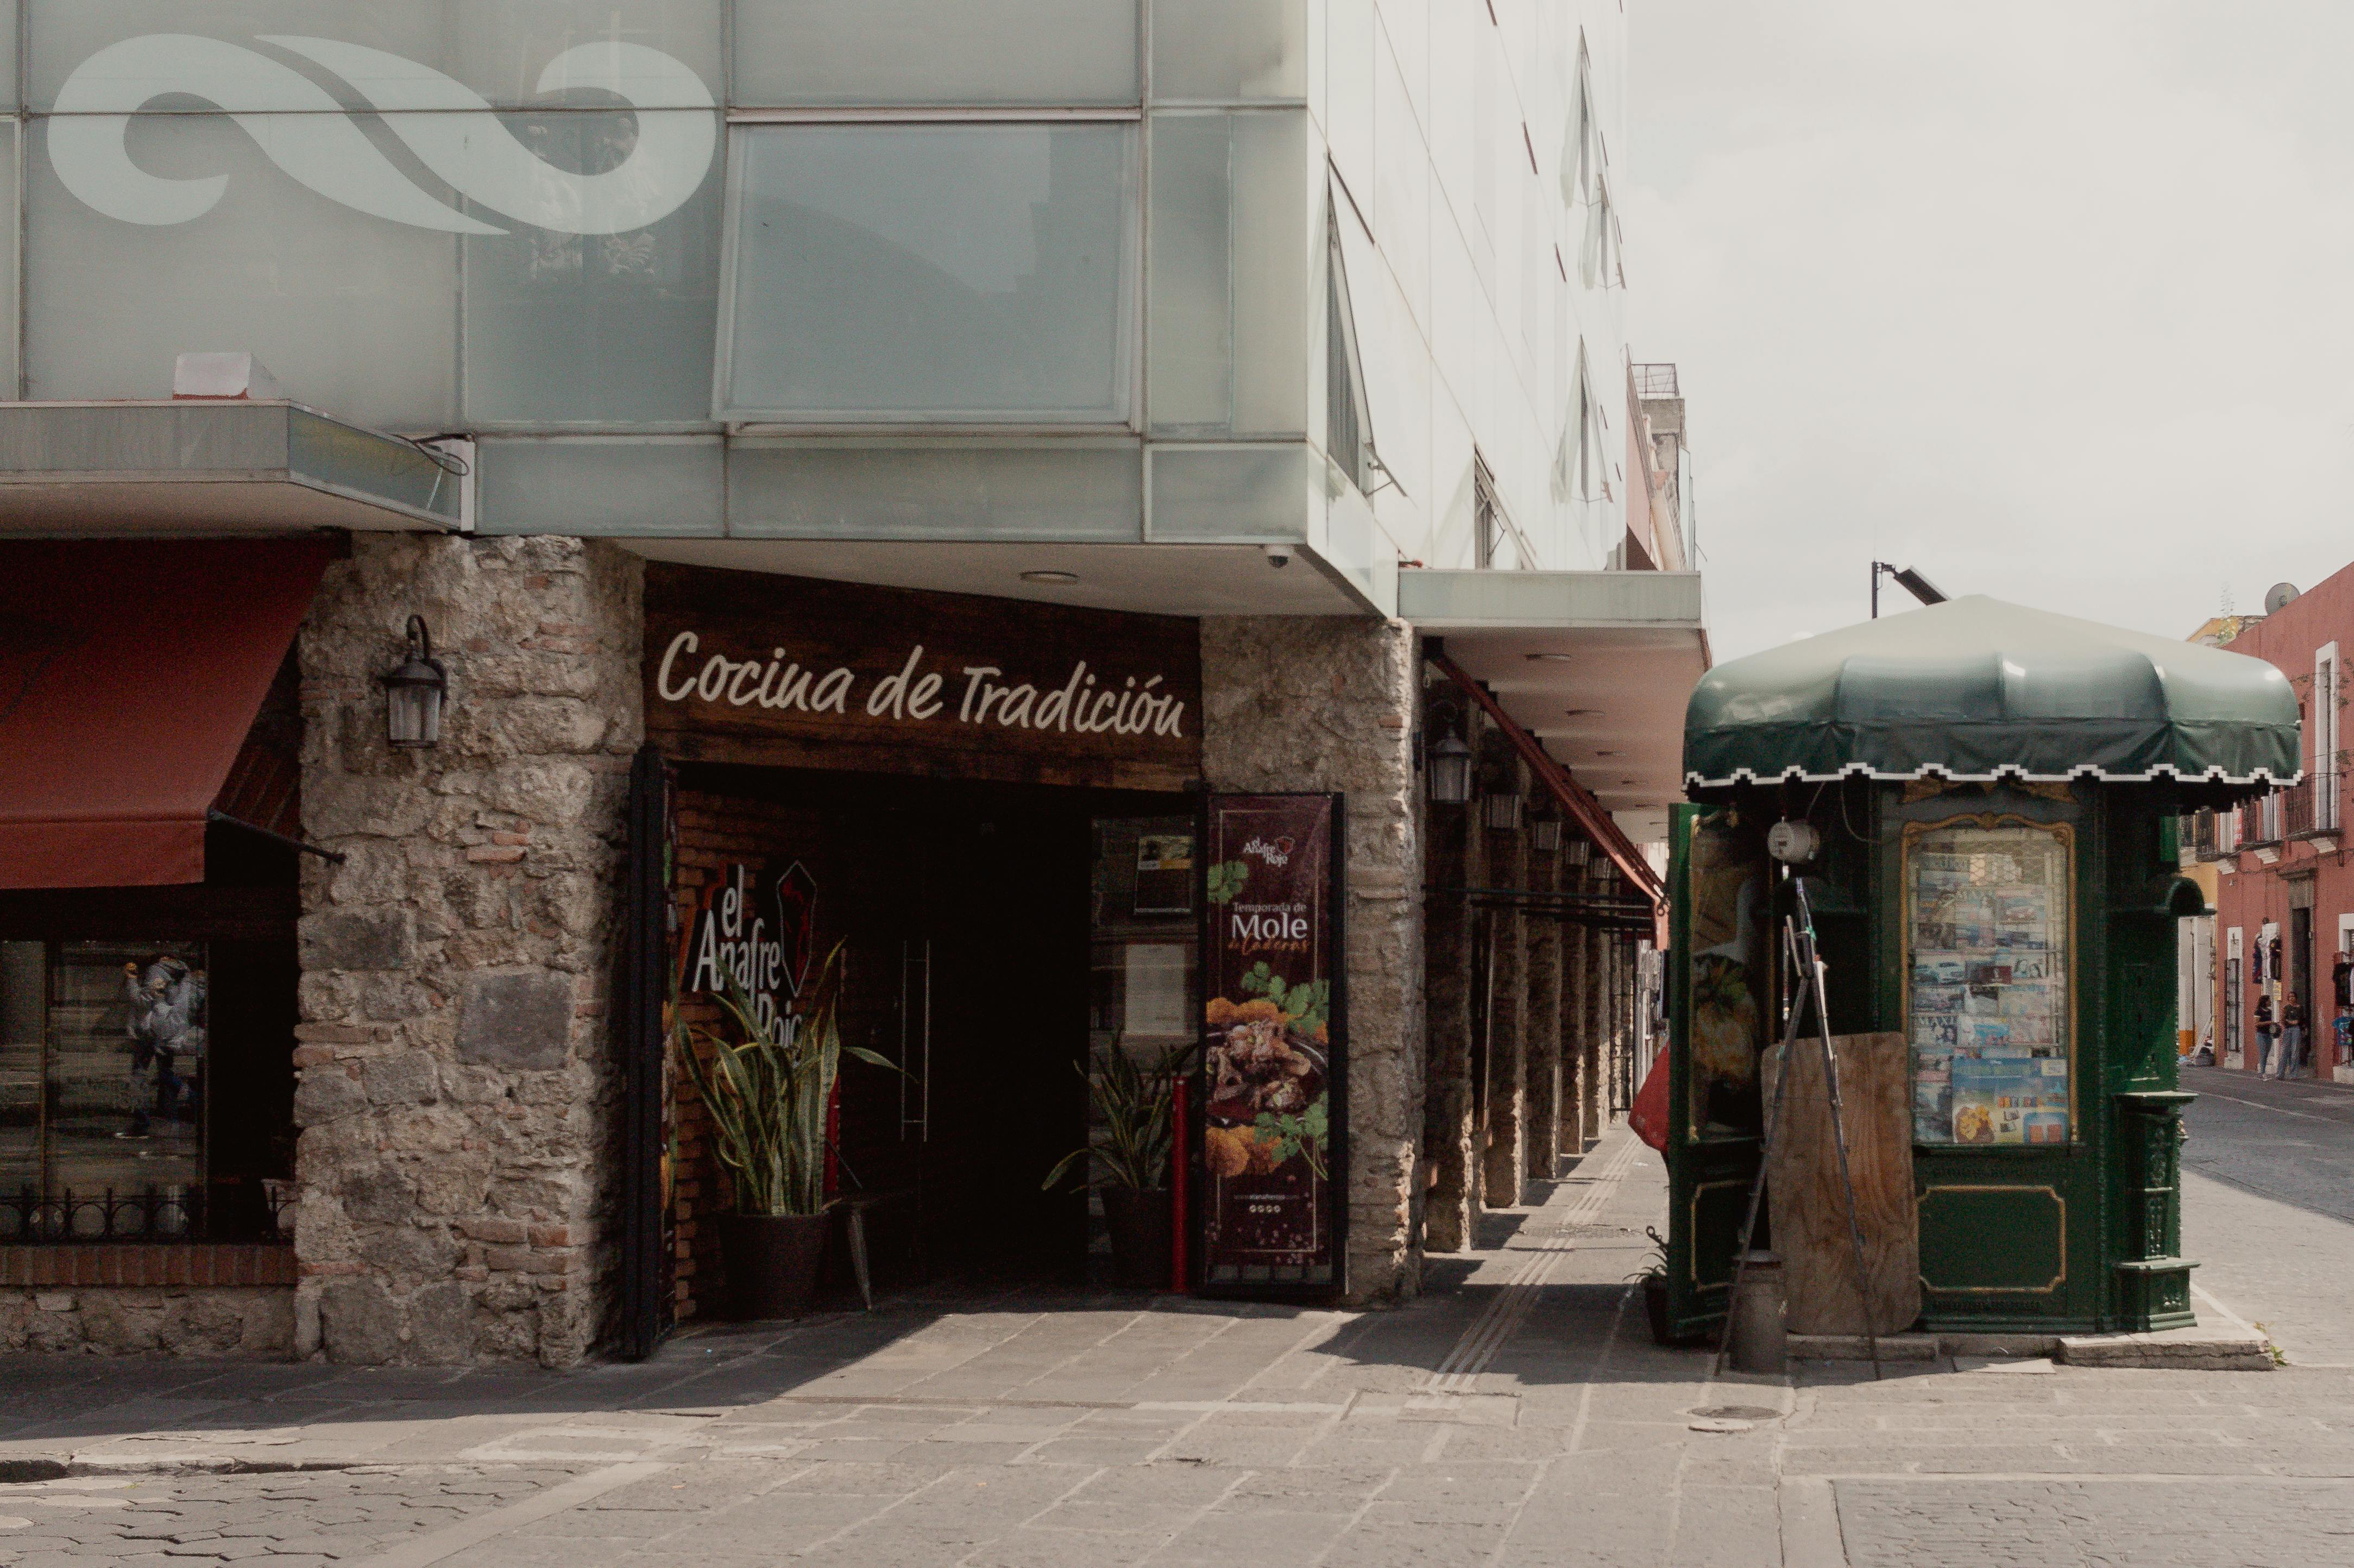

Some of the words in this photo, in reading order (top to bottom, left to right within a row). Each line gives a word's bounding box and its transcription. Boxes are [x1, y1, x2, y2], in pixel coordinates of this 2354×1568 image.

[658, 631, 853, 713] Cocina
[866, 645, 943, 721] de
[959, 660, 1185, 738] Tradición
[721, 863, 745, 937] el
[1231, 912, 1308, 941] Mole
[1232, 902, 1291, 914] Temporada
[1293, 902, 1307, 912] de
[691, 909, 781, 1005] Anafre
